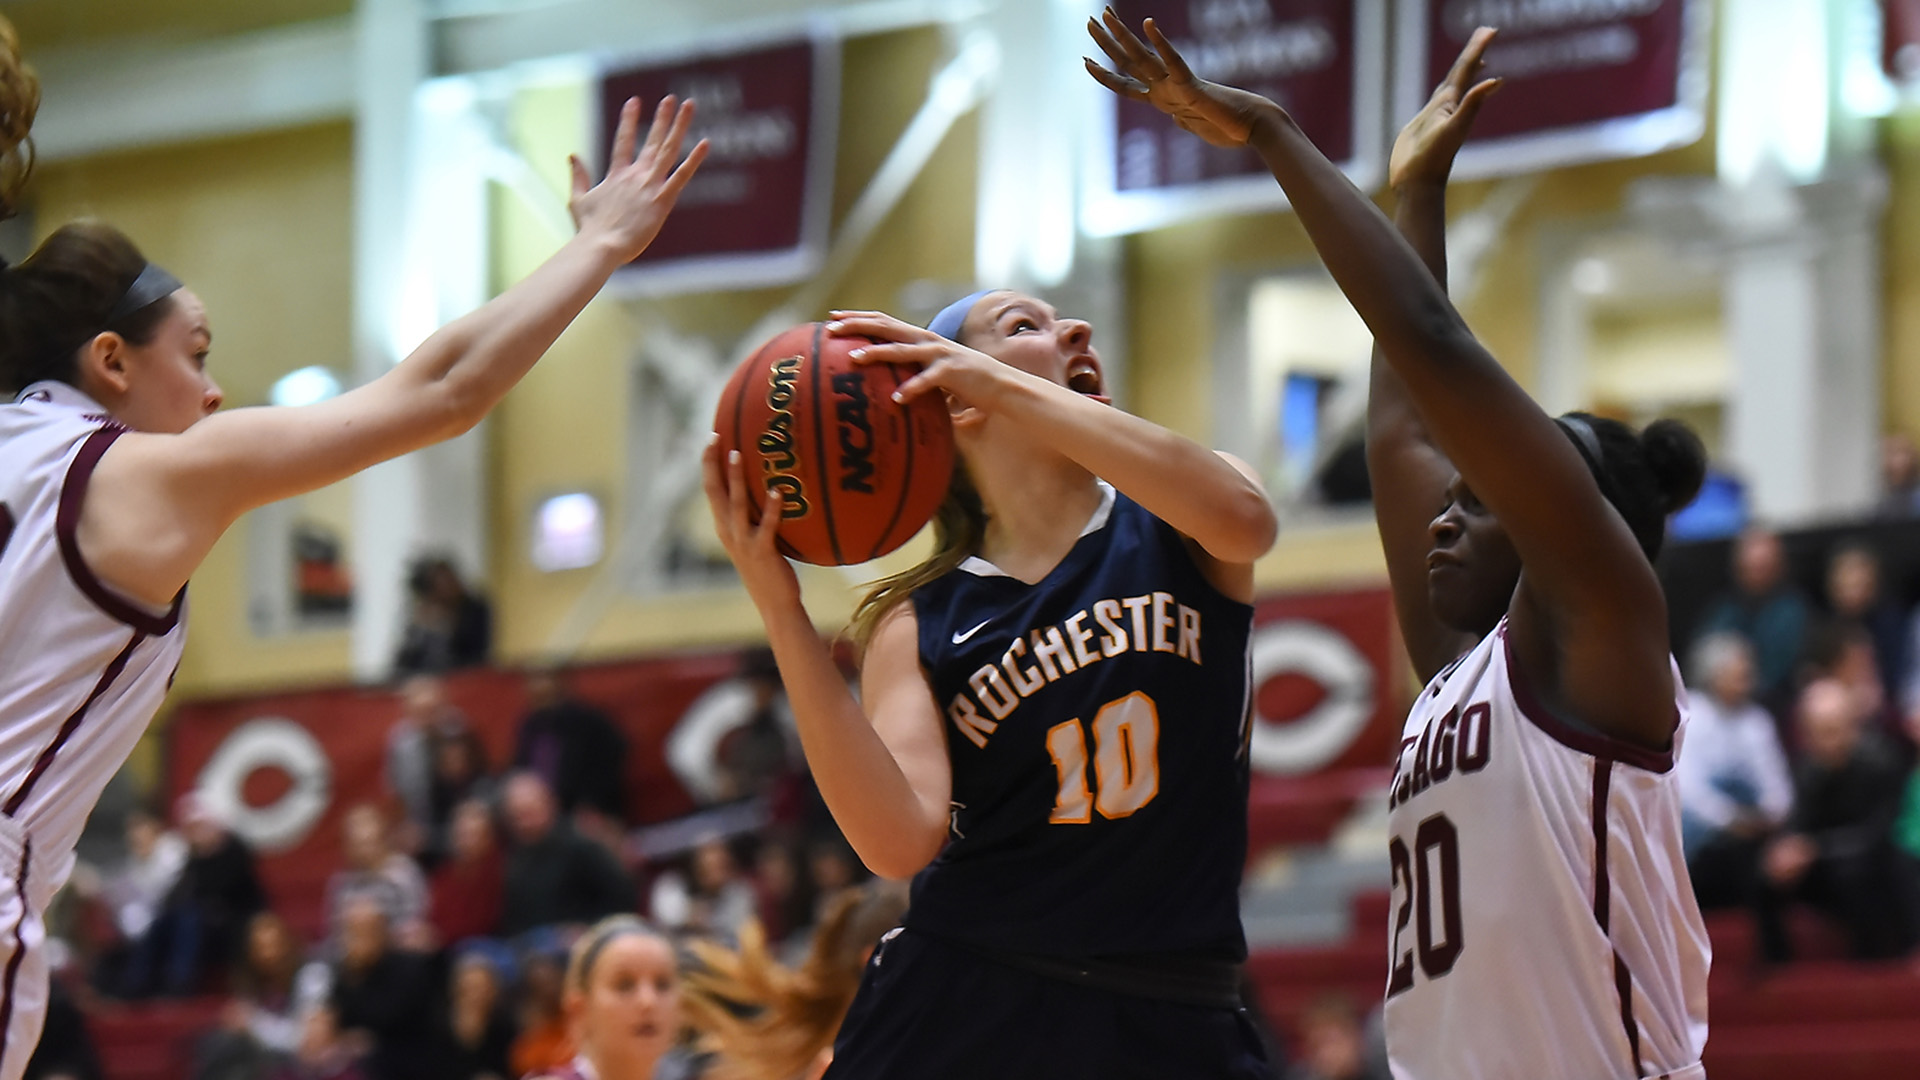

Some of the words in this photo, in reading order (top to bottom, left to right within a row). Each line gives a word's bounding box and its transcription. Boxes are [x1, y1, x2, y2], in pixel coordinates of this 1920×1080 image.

[757, 354, 811, 521] Wilson
[832, 371, 875, 494] NCAA
[950, 591, 1203, 749] ROCHESTER
[1046, 690, 1160, 824] 10
[1387, 812, 1464, 1000] 20
